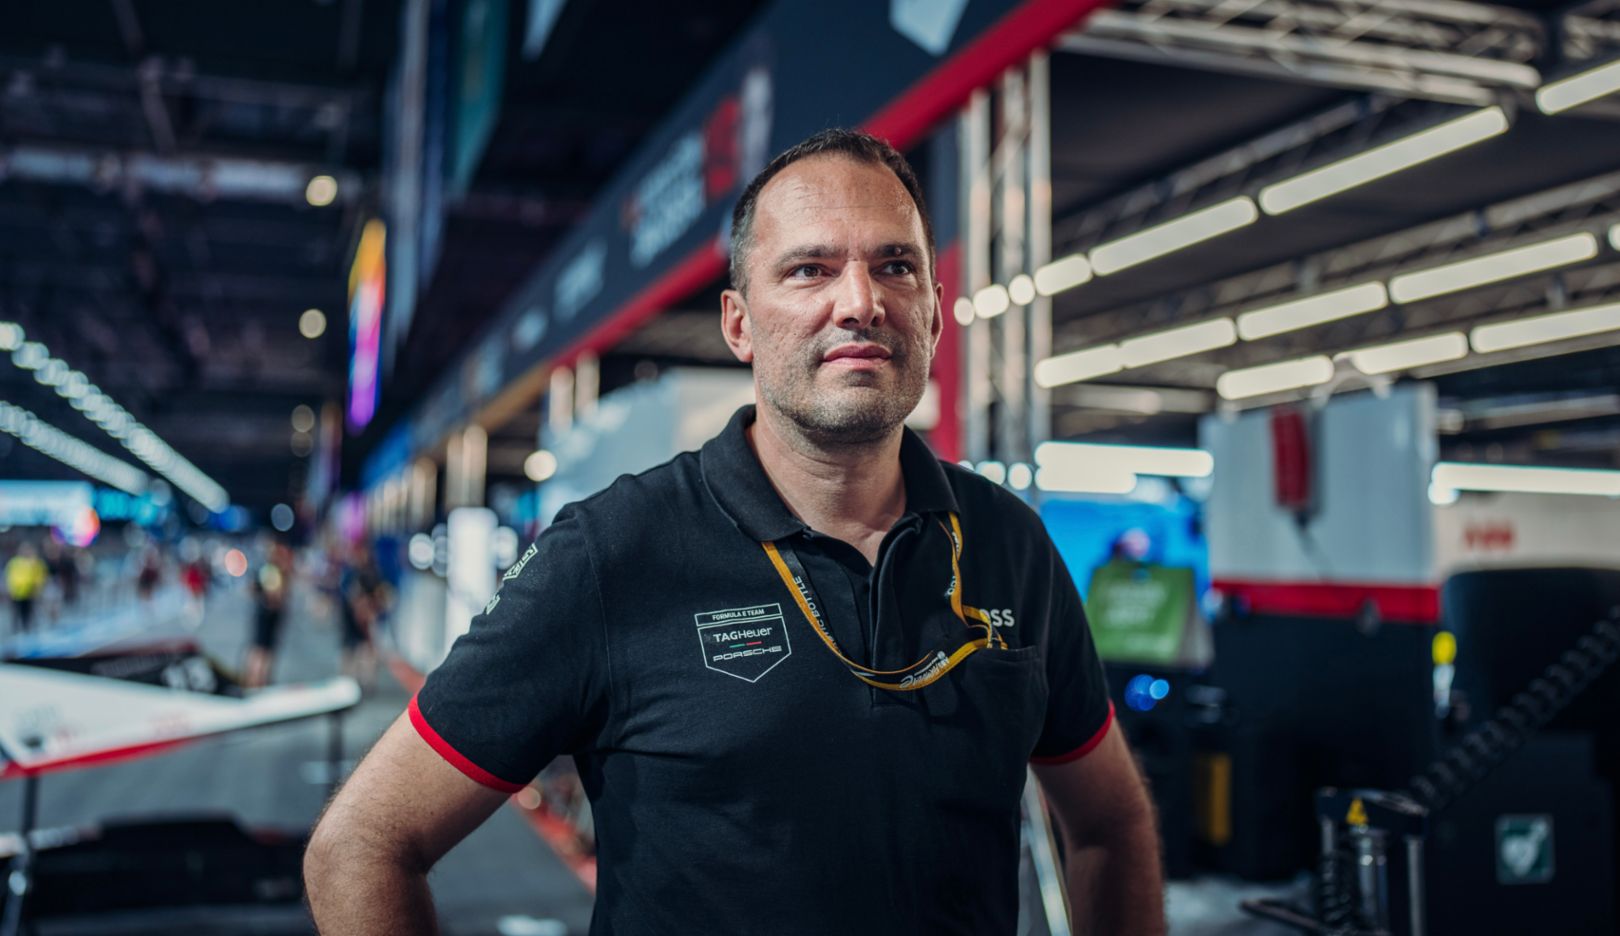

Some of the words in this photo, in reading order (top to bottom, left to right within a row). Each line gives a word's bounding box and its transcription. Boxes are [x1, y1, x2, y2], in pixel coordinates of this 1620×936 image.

[712, 611, 741, 621] FORMULA
[747, 608, 765, 617] TEAM
[713, 645, 782, 662] PORSCHE
